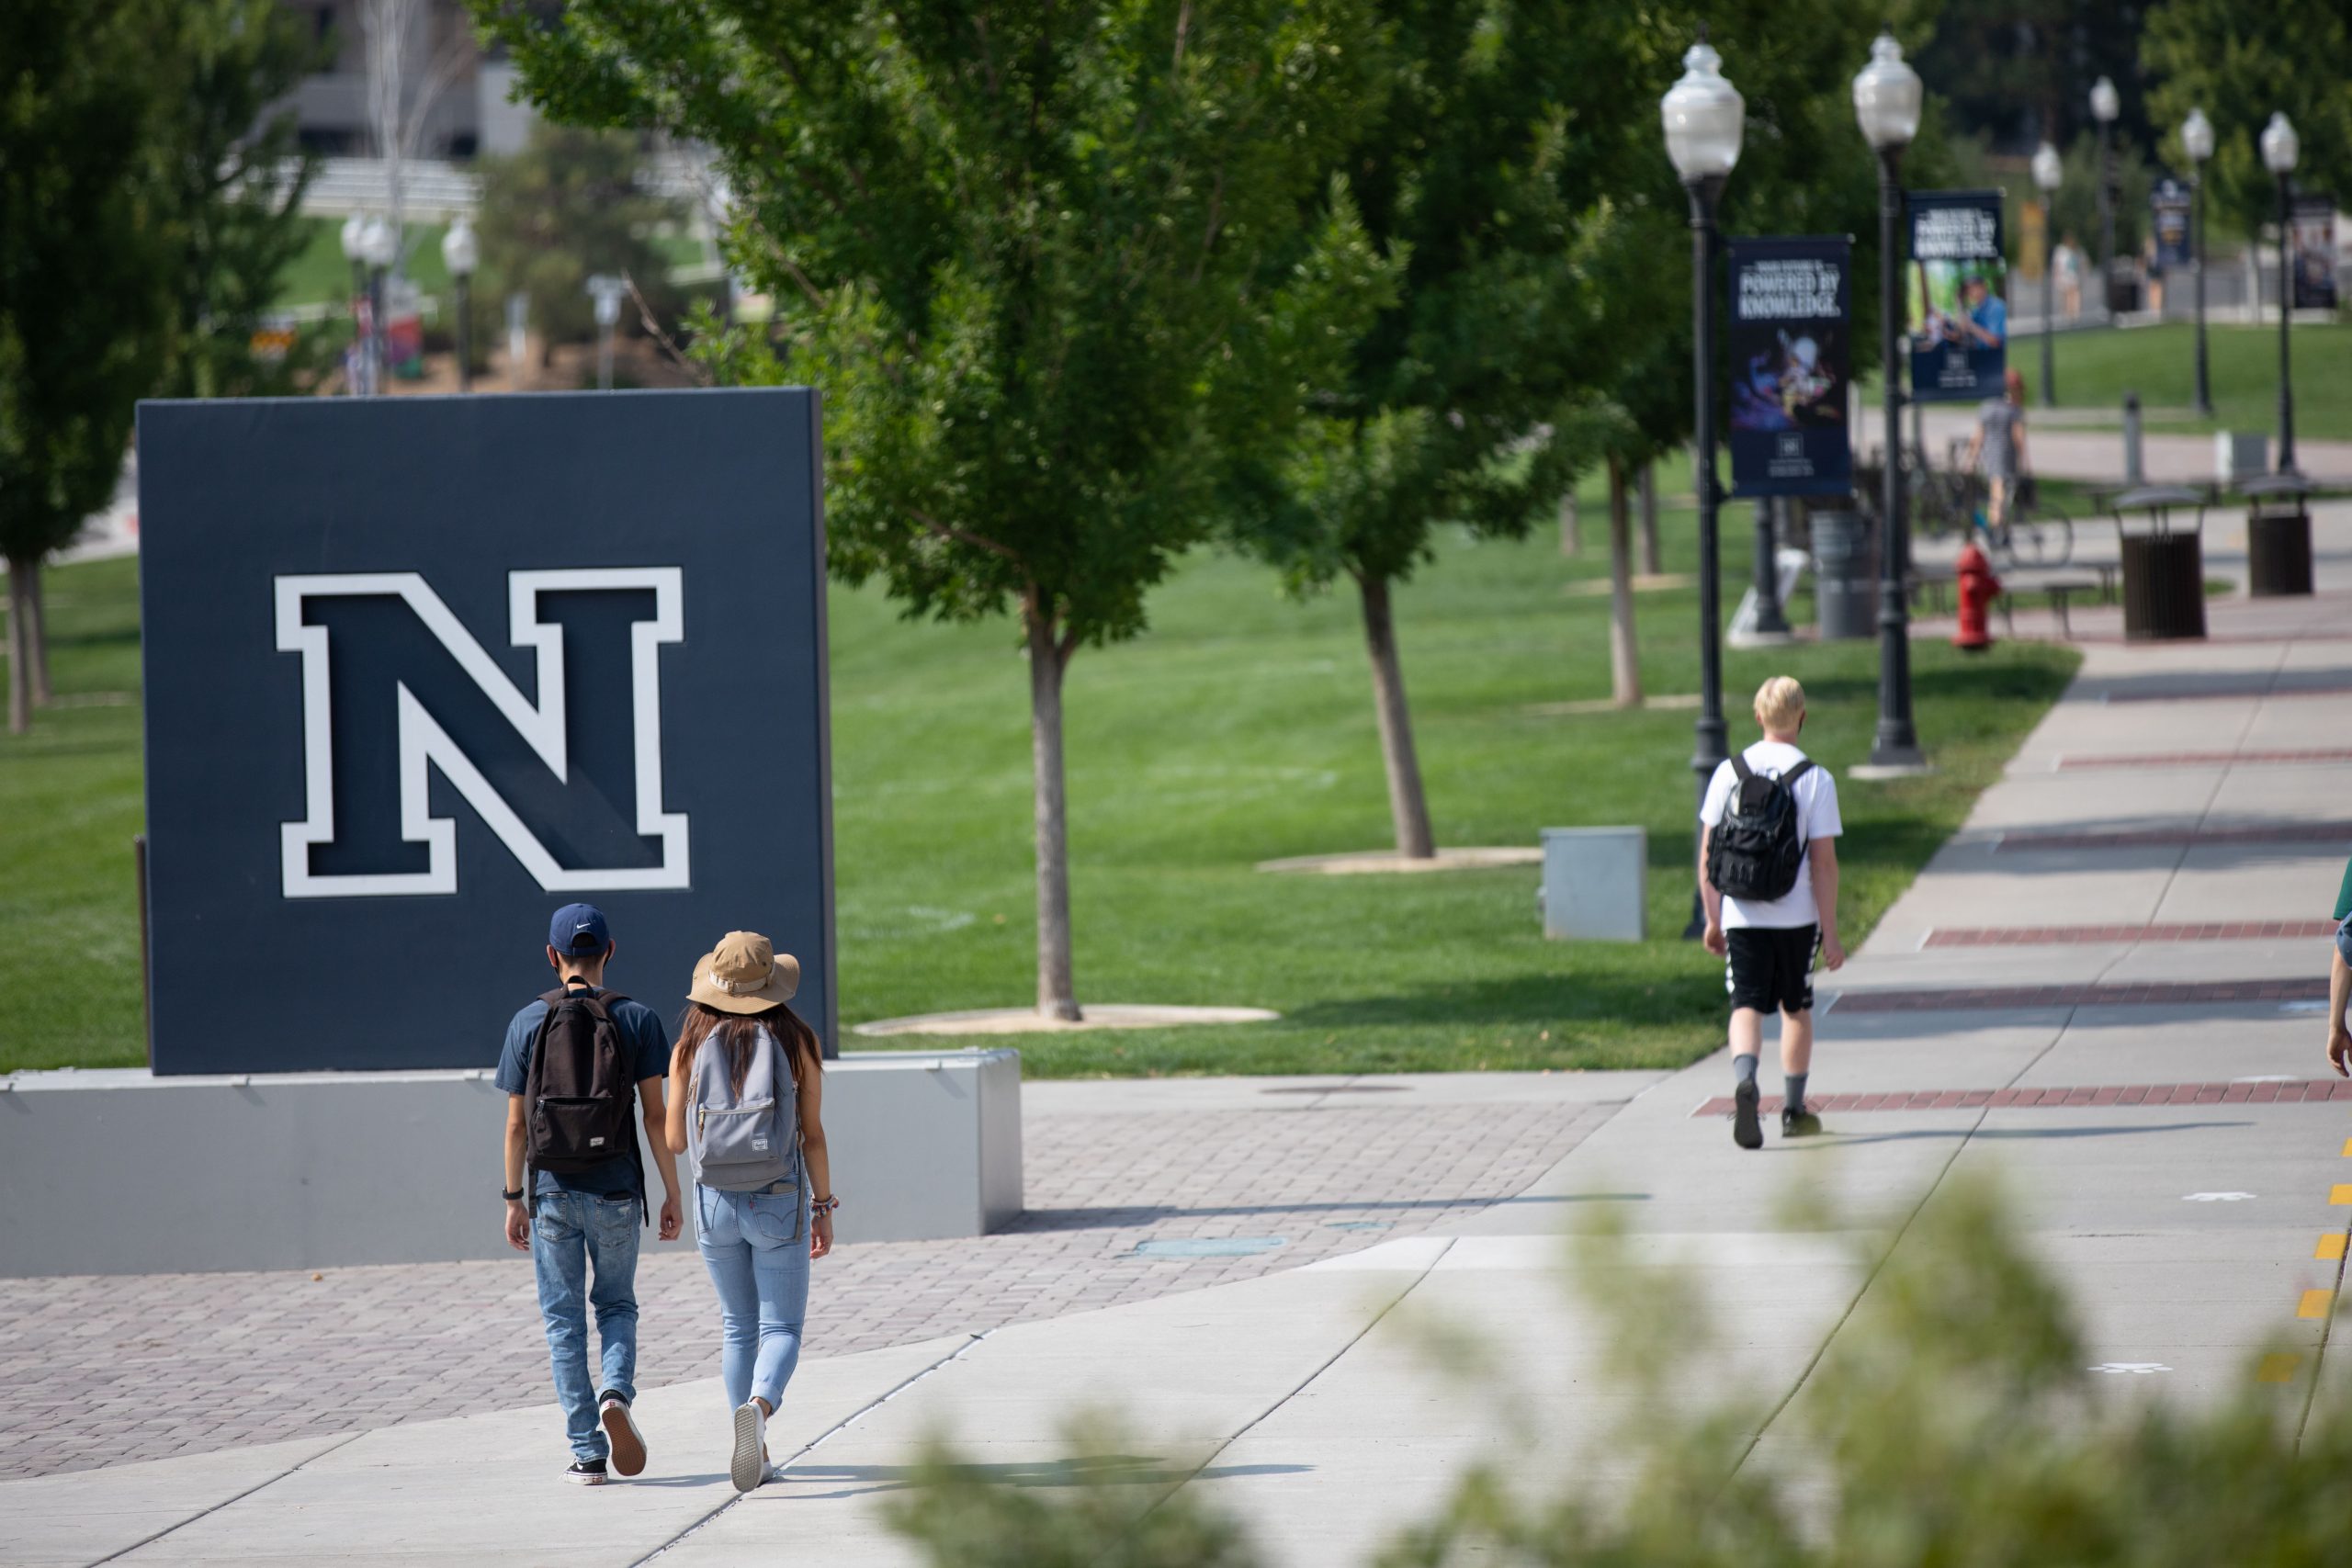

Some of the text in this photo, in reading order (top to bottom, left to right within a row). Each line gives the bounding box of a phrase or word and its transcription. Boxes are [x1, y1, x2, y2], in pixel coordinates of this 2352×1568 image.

[1740, 272, 1840, 294] POWERED BY
[1739, 294, 1841, 318] KNOWLEDGE.
[274, 566, 691, 898] N
